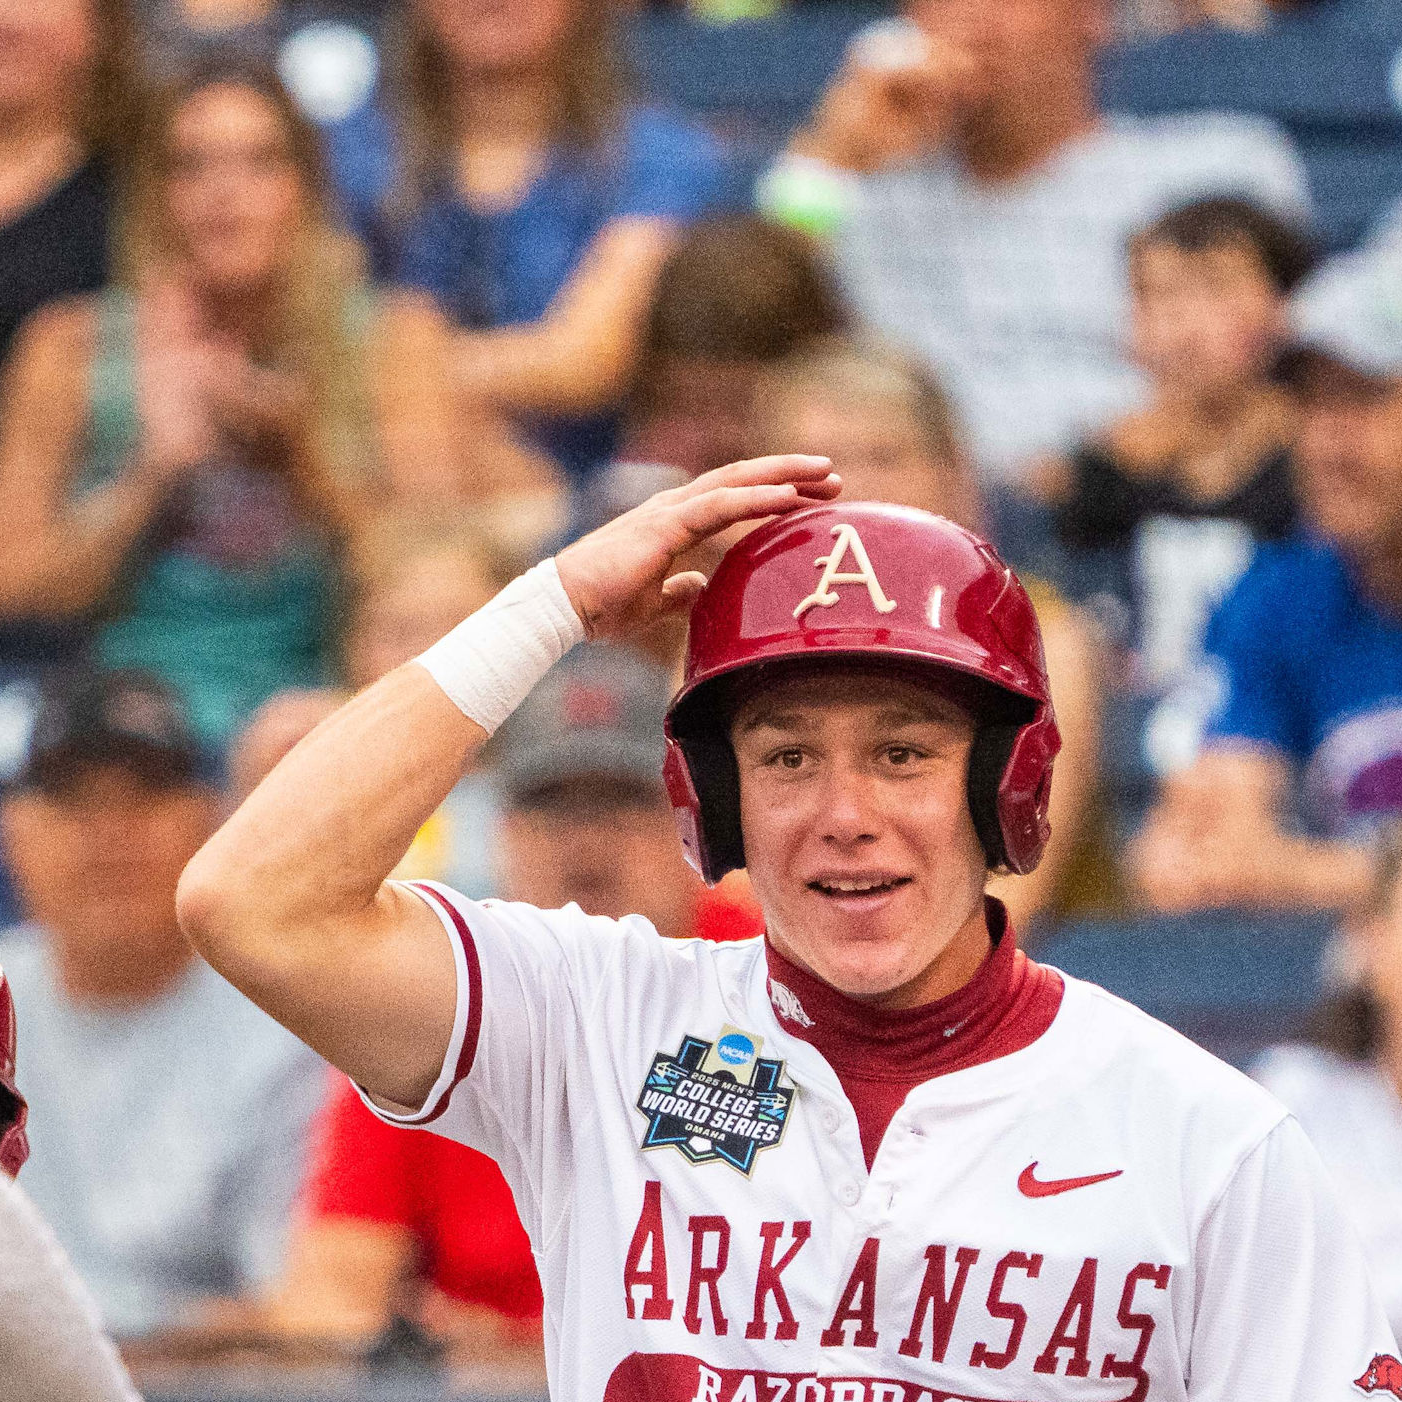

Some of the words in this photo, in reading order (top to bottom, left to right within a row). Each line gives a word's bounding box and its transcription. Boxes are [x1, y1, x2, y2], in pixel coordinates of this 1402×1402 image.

[791, 522, 898, 619] A
[675, 1079, 760, 1118] COLLEGE
[691, 1071, 719, 1086] 2025
[721, 1081, 755, 1098] MEN'S
[641, 1090, 712, 1124] WORLD
[709, 1111, 780, 1142] SERIES
[684, 1122, 727, 1142] OMAHA
[623, 1180, 1173, 1381] ARKANSAS
